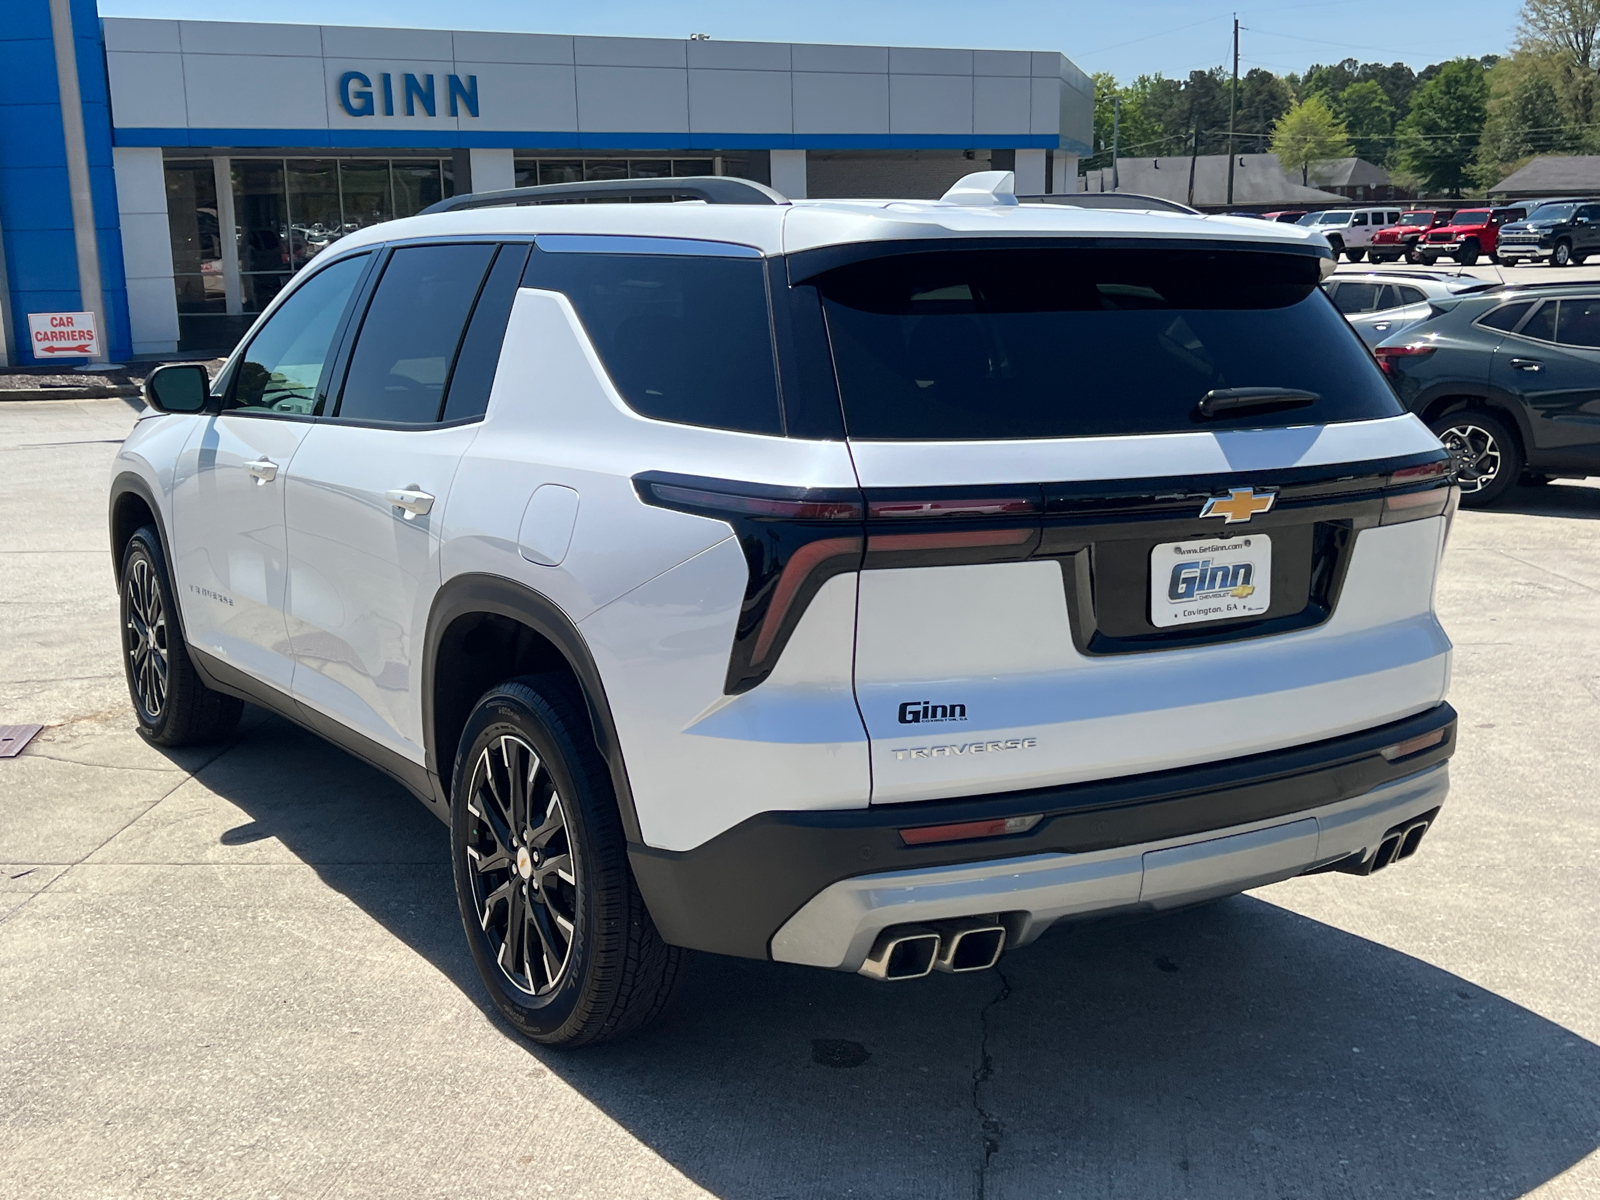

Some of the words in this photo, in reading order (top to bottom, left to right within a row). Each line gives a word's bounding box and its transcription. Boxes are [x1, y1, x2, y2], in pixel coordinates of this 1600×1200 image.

[339, 71, 480, 118] GINN
[50, 317, 75, 328] CAR
[34, 330, 94, 342] CARRIERS
[1179, 543, 1243, 555] www.GetGinn.com
[1168, 560, 1253, 600] Ginn
[189, 584, 234, 606] TRAVERSE
[1199, 592, 1230, 600] CHEVROLET
[1183, 606, 1223, 618] Covington,
[1226, 603, 1238, 611] GA
[898, 701, 966, 724] Ginn
[891, 737, 1037, 760] TRAVERSE
